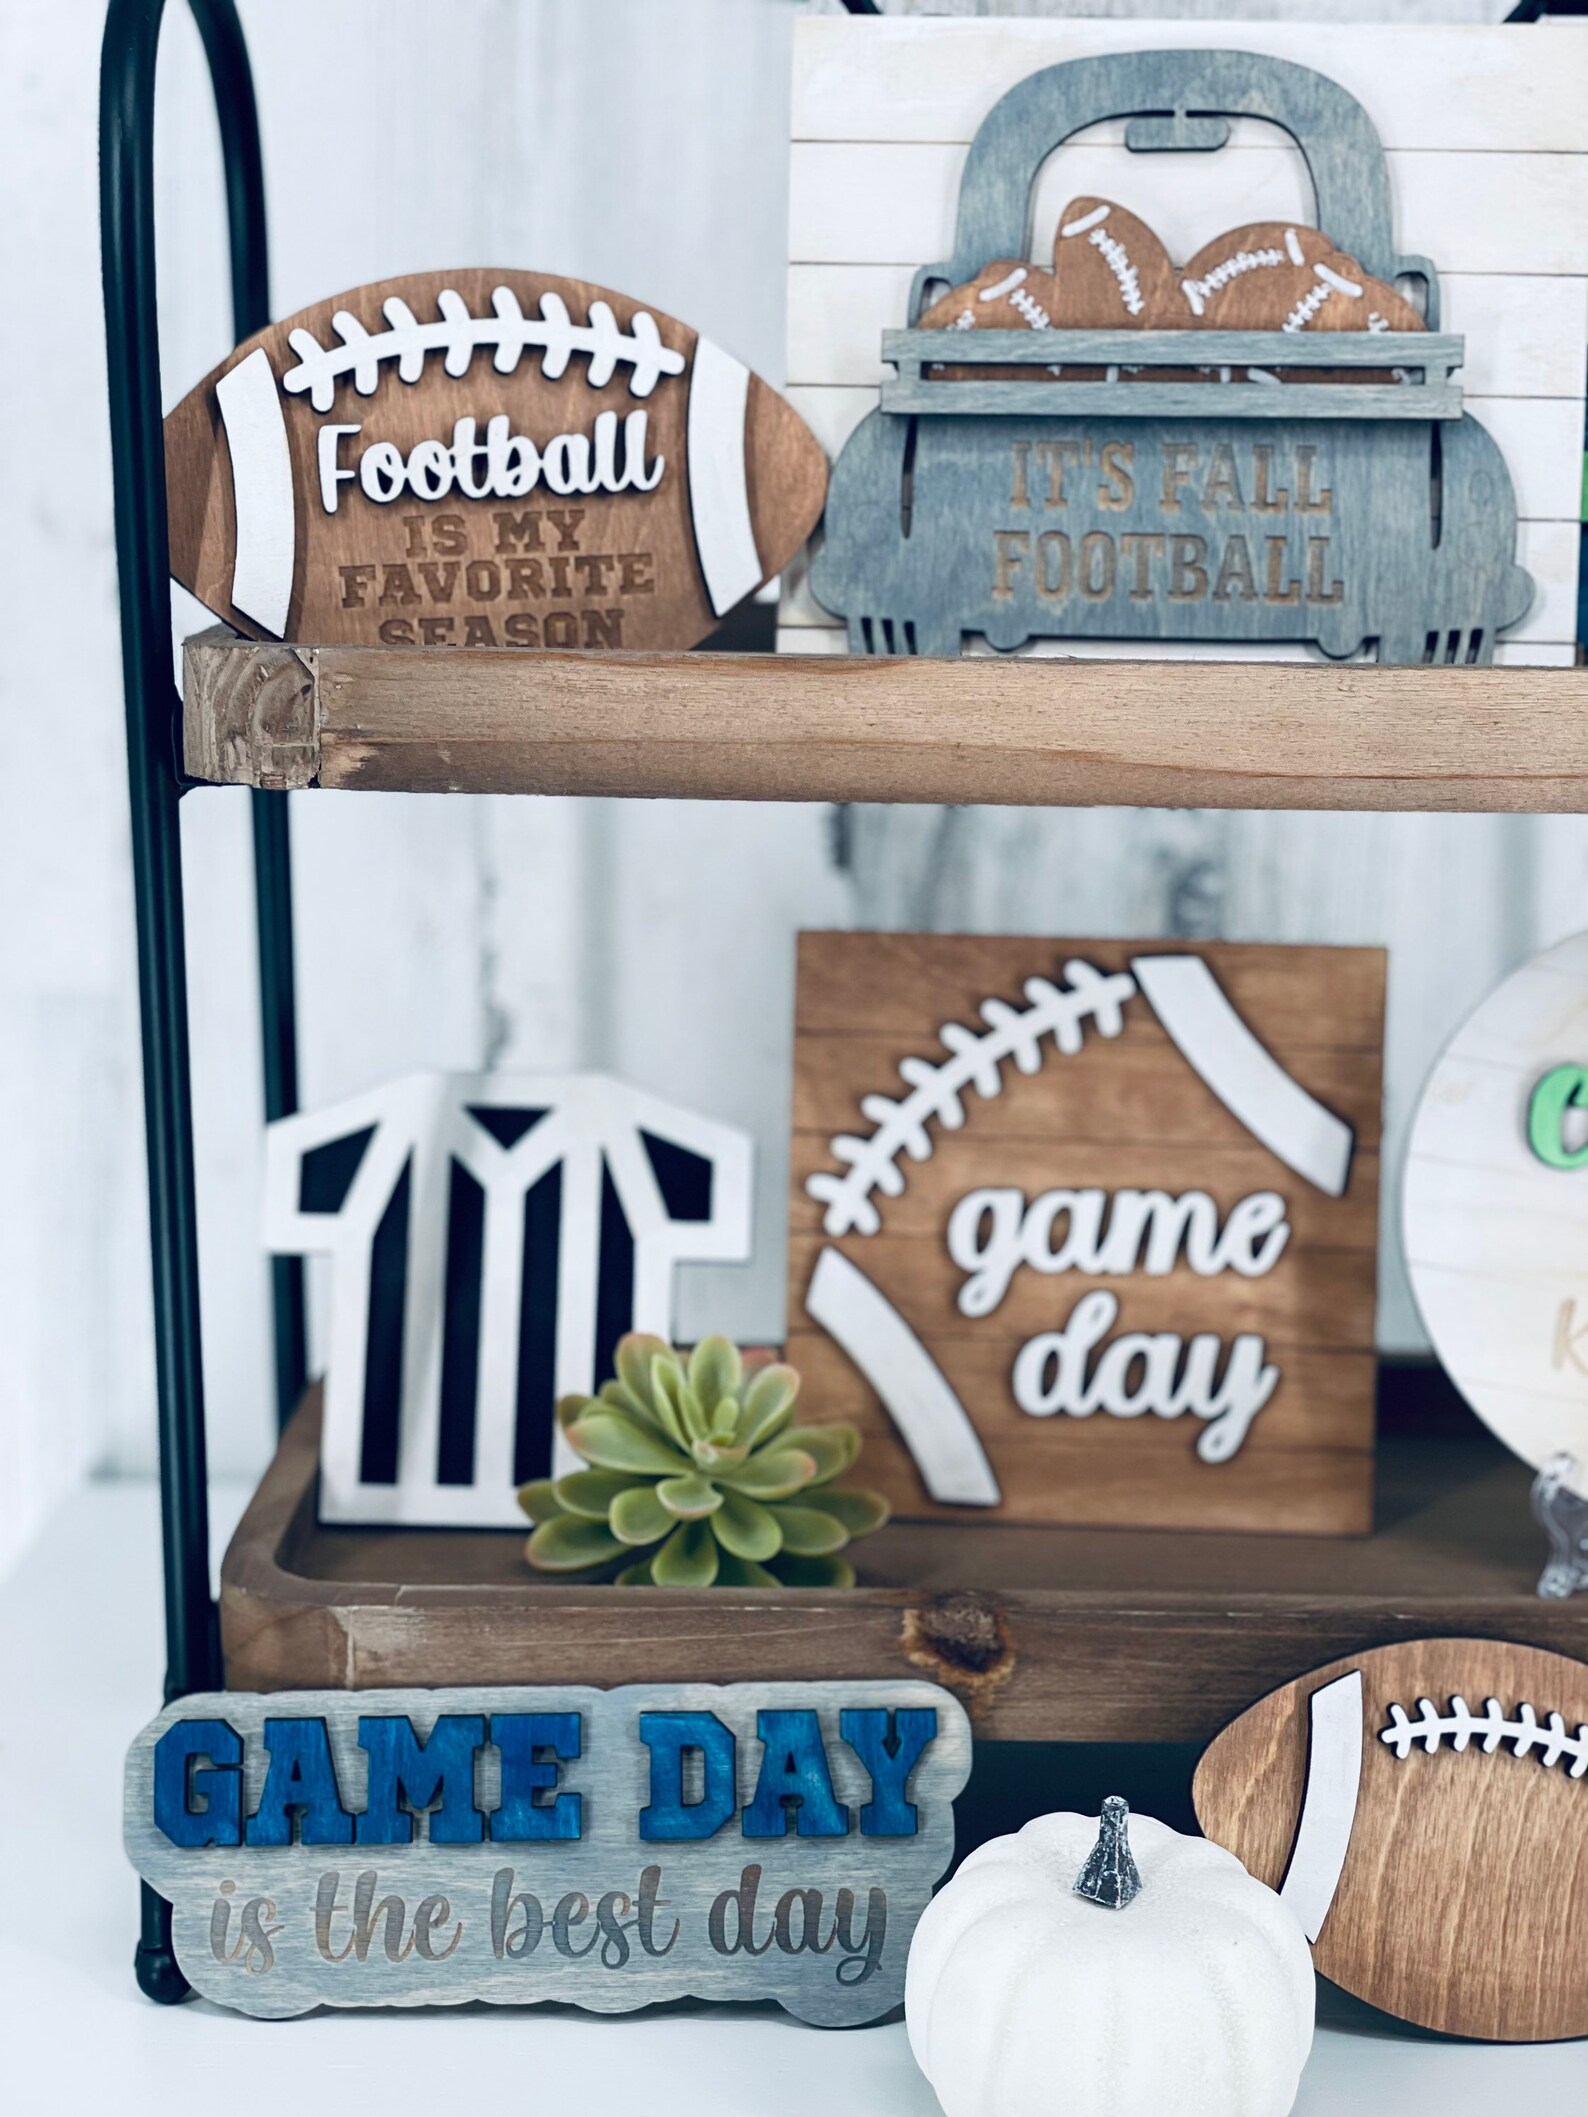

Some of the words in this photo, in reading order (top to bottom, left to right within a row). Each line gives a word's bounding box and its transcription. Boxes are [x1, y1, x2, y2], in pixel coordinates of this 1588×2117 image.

[317, 409, 665, 514] Football
[1010, 440, 1135, 511] IT'S
[1160, 443, 1333, 513] FALL
[403, 514, 467, 557] IS
[492, 509, 585, 552] MY
[992, 529, 1344, 603] FOOTBALL
[338, 553, 654, 608] FAVORITE
[378, 609, 624, 648] SEASON
[947, 1188, 1290, 1318] game
[1012, 1290, 1280, 1464] day
[153, 1711, 583, 1847] GAME
[639, 1708, 938, 1842] DAY
[209, 1880, 285, 1977] is
[310, 1869, 463, 1963] the
[490, 1865, 680, 1970] best
[709, 1864, 888, 1987] day
